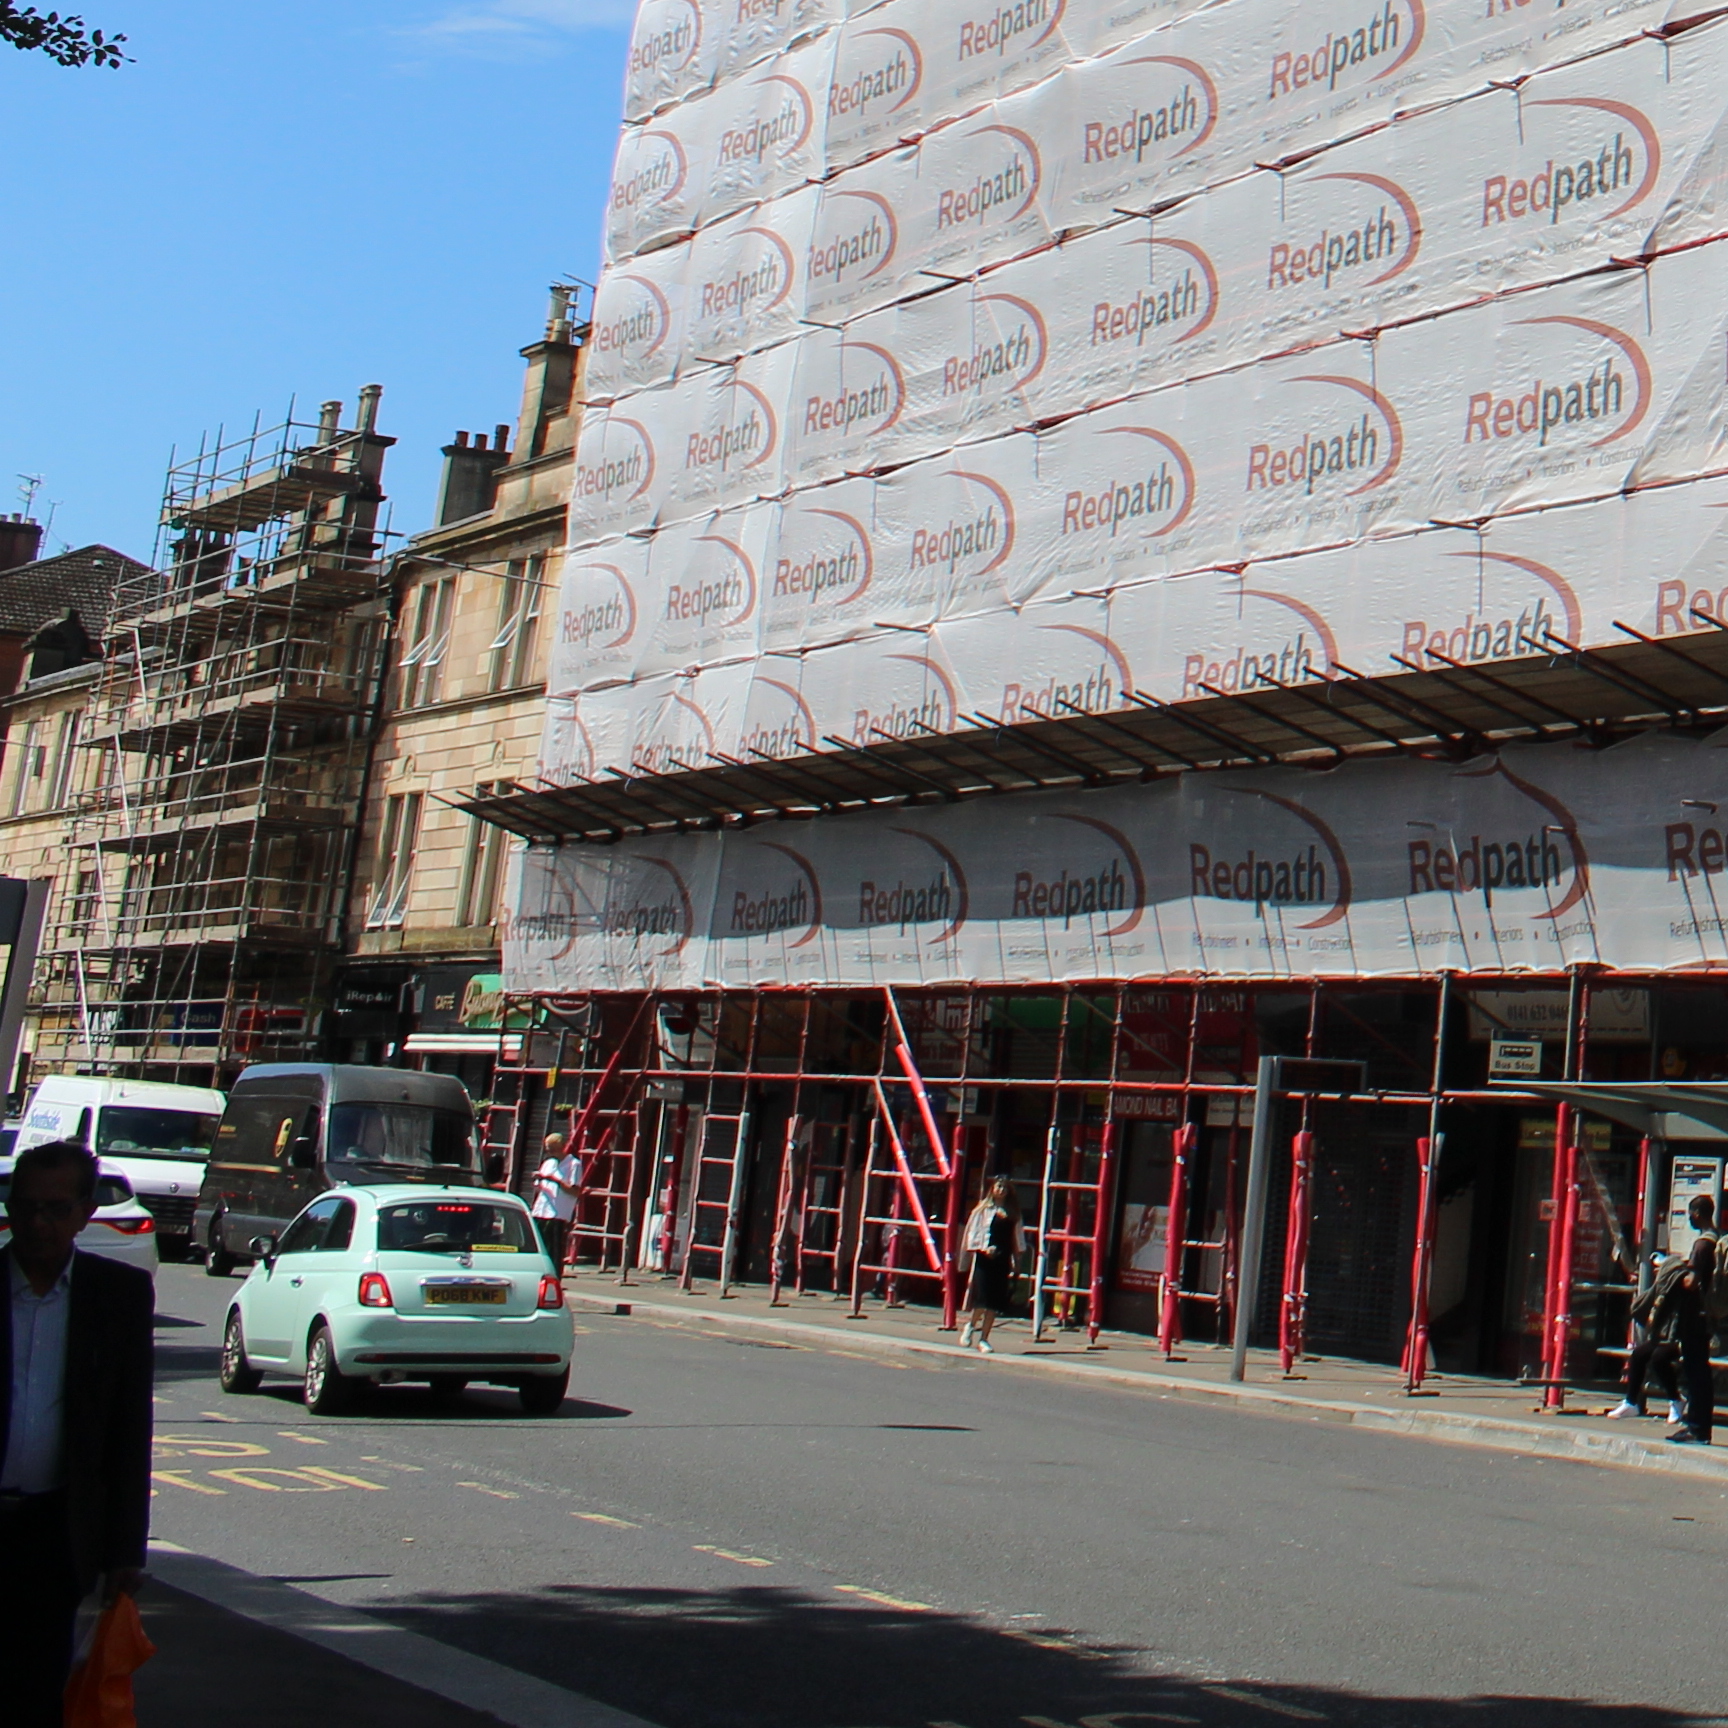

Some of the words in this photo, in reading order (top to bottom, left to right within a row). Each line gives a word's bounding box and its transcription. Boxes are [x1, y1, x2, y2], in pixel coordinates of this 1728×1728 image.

[1270, 1, 1398, 97] Redpath
[719, 101, 796, 166] Redpath
[1085, 85, 1196, 164] Redpath
[938, 154, 1025, 229] Redpath
[1482, 132, 1633, 227] Redpath
[1269, 206, 1394, 288] Redpath
[703, 255, 778, 318] Redpath
[1092, 269, 1198, 345] Redpath
[943, 324, 1030, 396] Redpath
[805, 373, 887, 436] Redpath
[1463, 357, 1623, 446] Redpath
[686, 410, 760, 471] Redpath
[1247, 414, 1376, 493] Redpath
[1063, 463, 1173, 536] Redpath
[773, 543, 858, 602] Redpath
[910, 503, 996, 574] Redpath
[562, 595, 622, 646] Redpath
[668, 571, 741, 625] Redpath
[1013, 860, 1125, 930] Redpath
[1191, 846, 1325, 916] Redpath
[1408, 826, 1560, 907] Redpath
[732, 880, 807, 941] Redpath
[859, 872, 950, 935] Redpath
[1495, 1060, 1512, 1070] Bus
[1515, 1060, 1536, 1073] Stop
